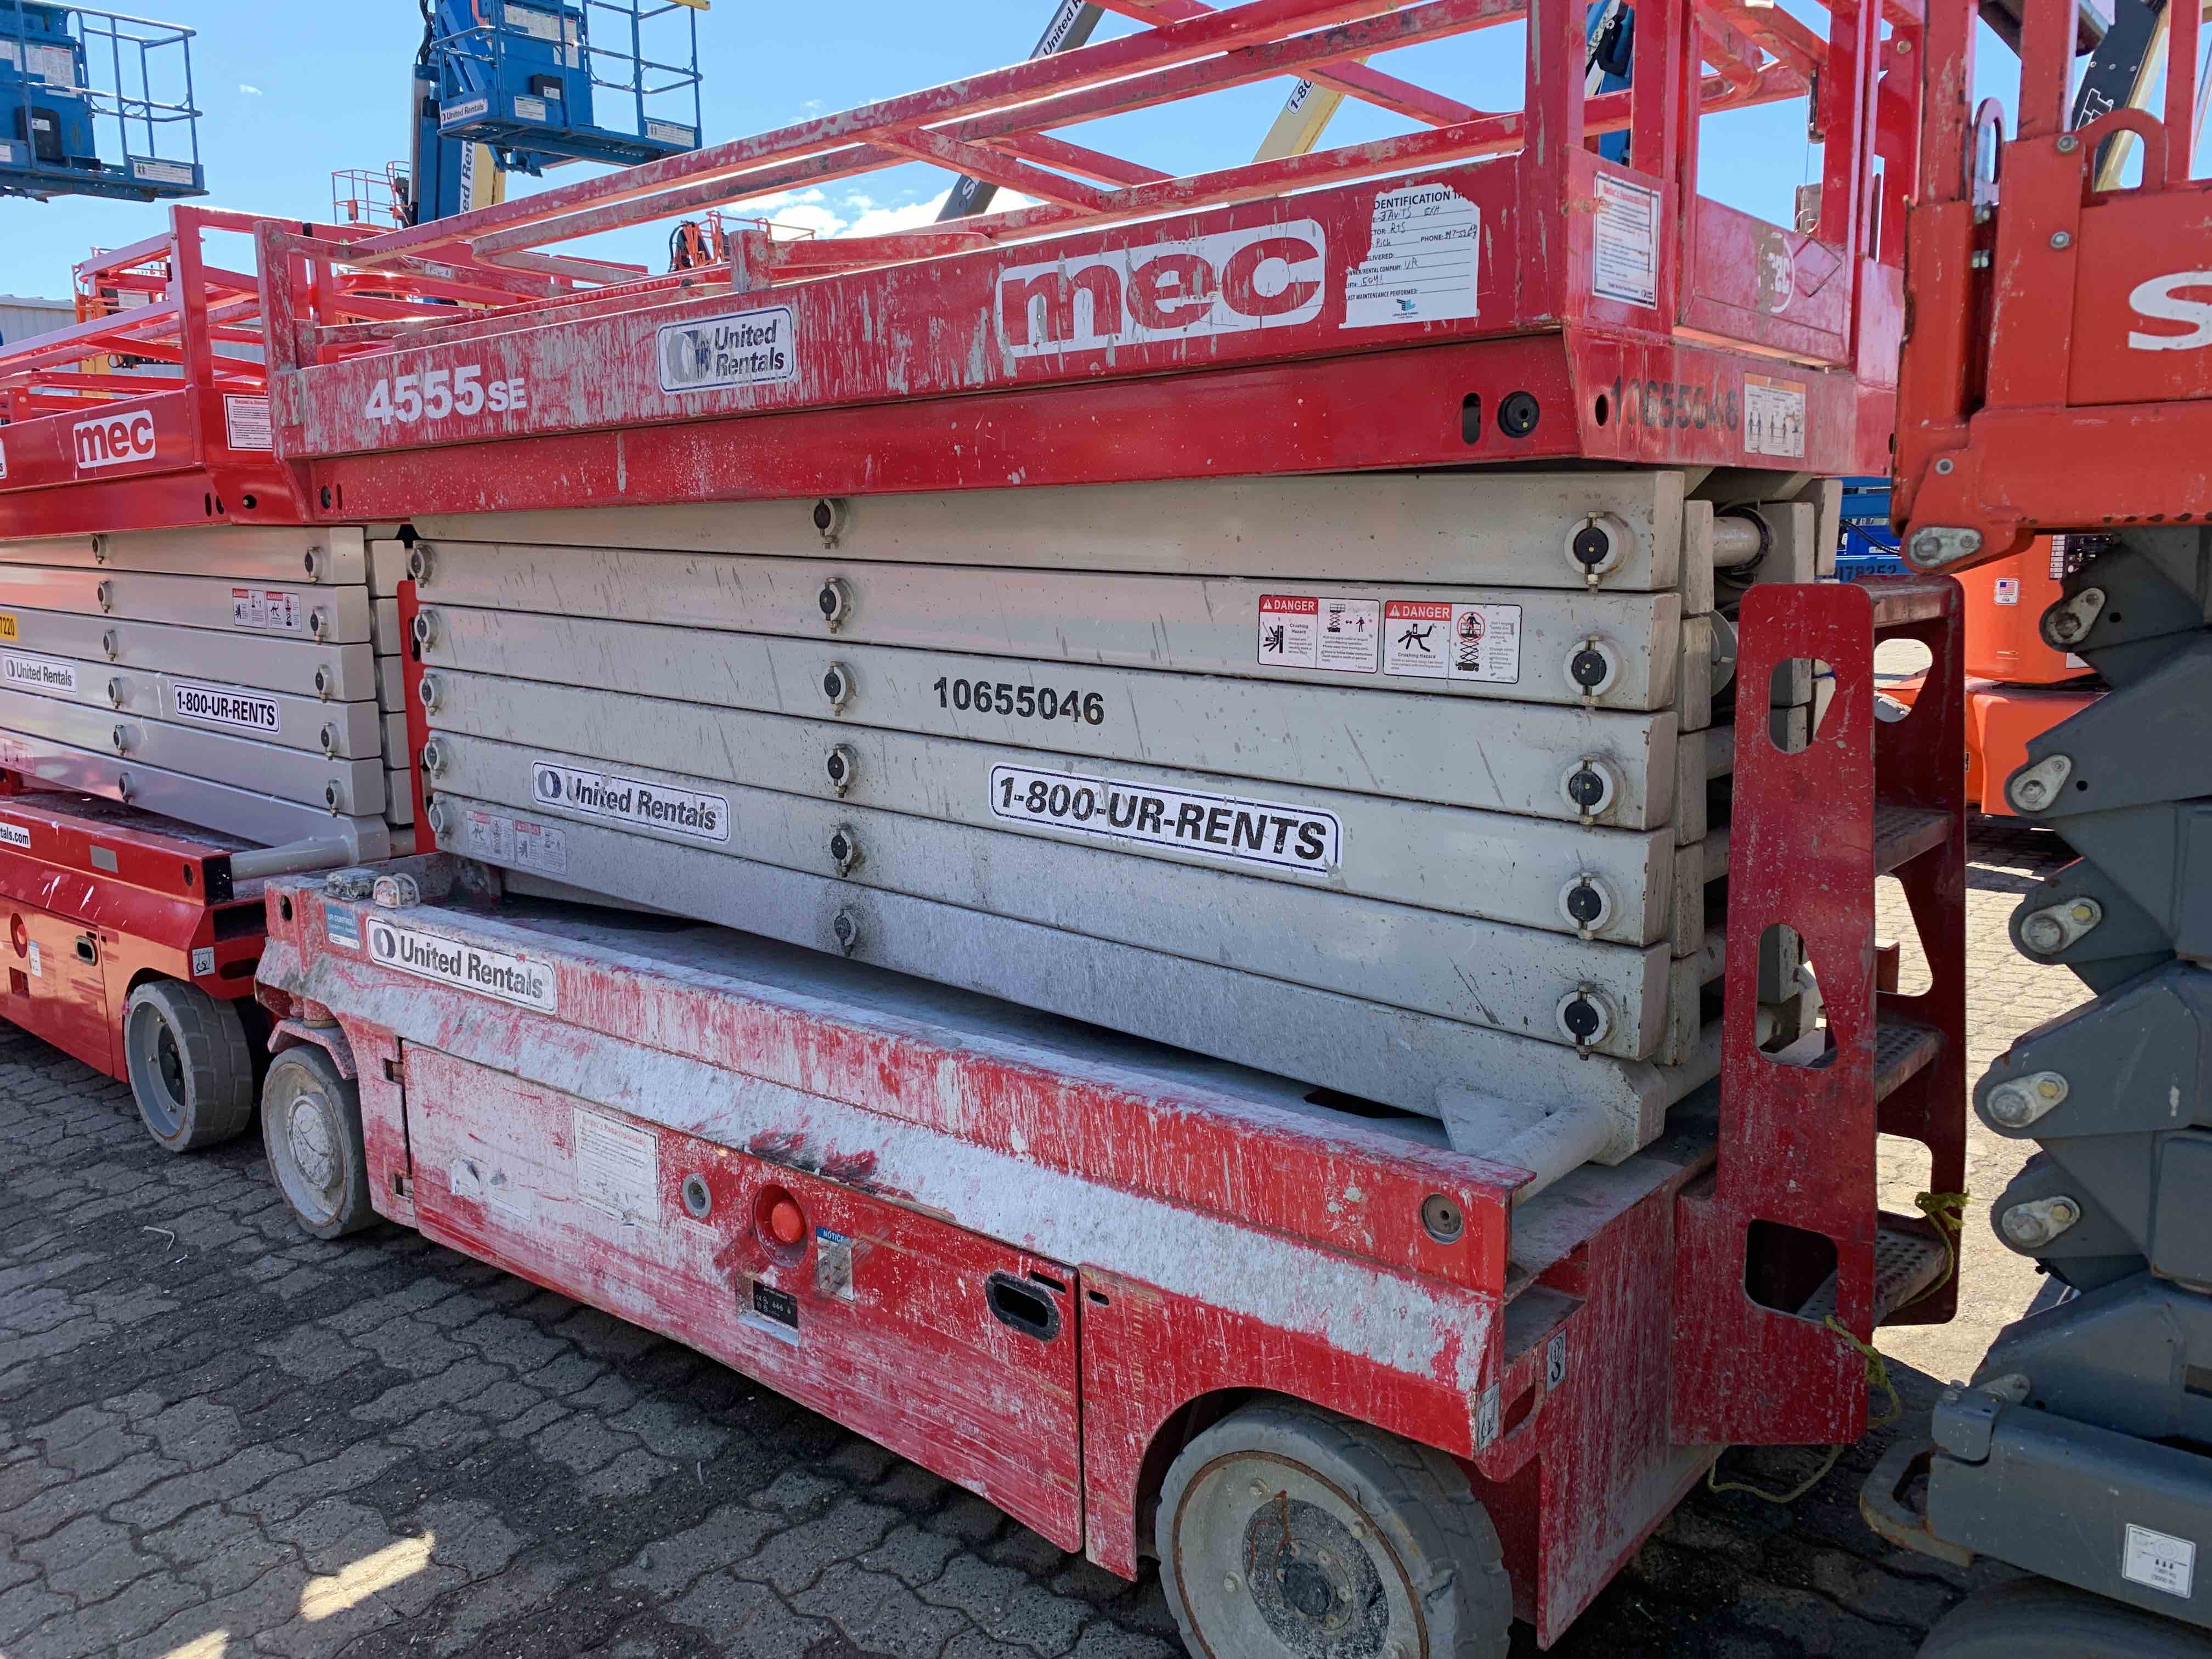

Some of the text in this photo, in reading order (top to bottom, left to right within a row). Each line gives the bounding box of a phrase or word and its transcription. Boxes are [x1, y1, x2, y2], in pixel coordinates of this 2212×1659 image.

[1043, 7, 1074, 55] United
[446, 103, 485, 120] United Rentals
[1002, 237, 1321, 346] mec
[715, 319, 777, 352] United
[716, 345, 785, 377] Rentals
[75, 416, 154, 463] mec
[1274, 599, 1314, 611] DANGER
[1402, 605, 1450, 618] DANGER
[16, 662, 71, 686] United Rentals
[177, 690, 275, 726] 1-800-UR-RENTS
[933, 676, 1105, 725] 10655046
[566, 776, 716, 831] United Rentals
[1000, 776, 1326, 861] 1-800-UR-RENTS
[400, 935, 461, 977] United
[467, 953, 543, 998] Rentals
[823, 1228, 844, 1243] NOTICE
